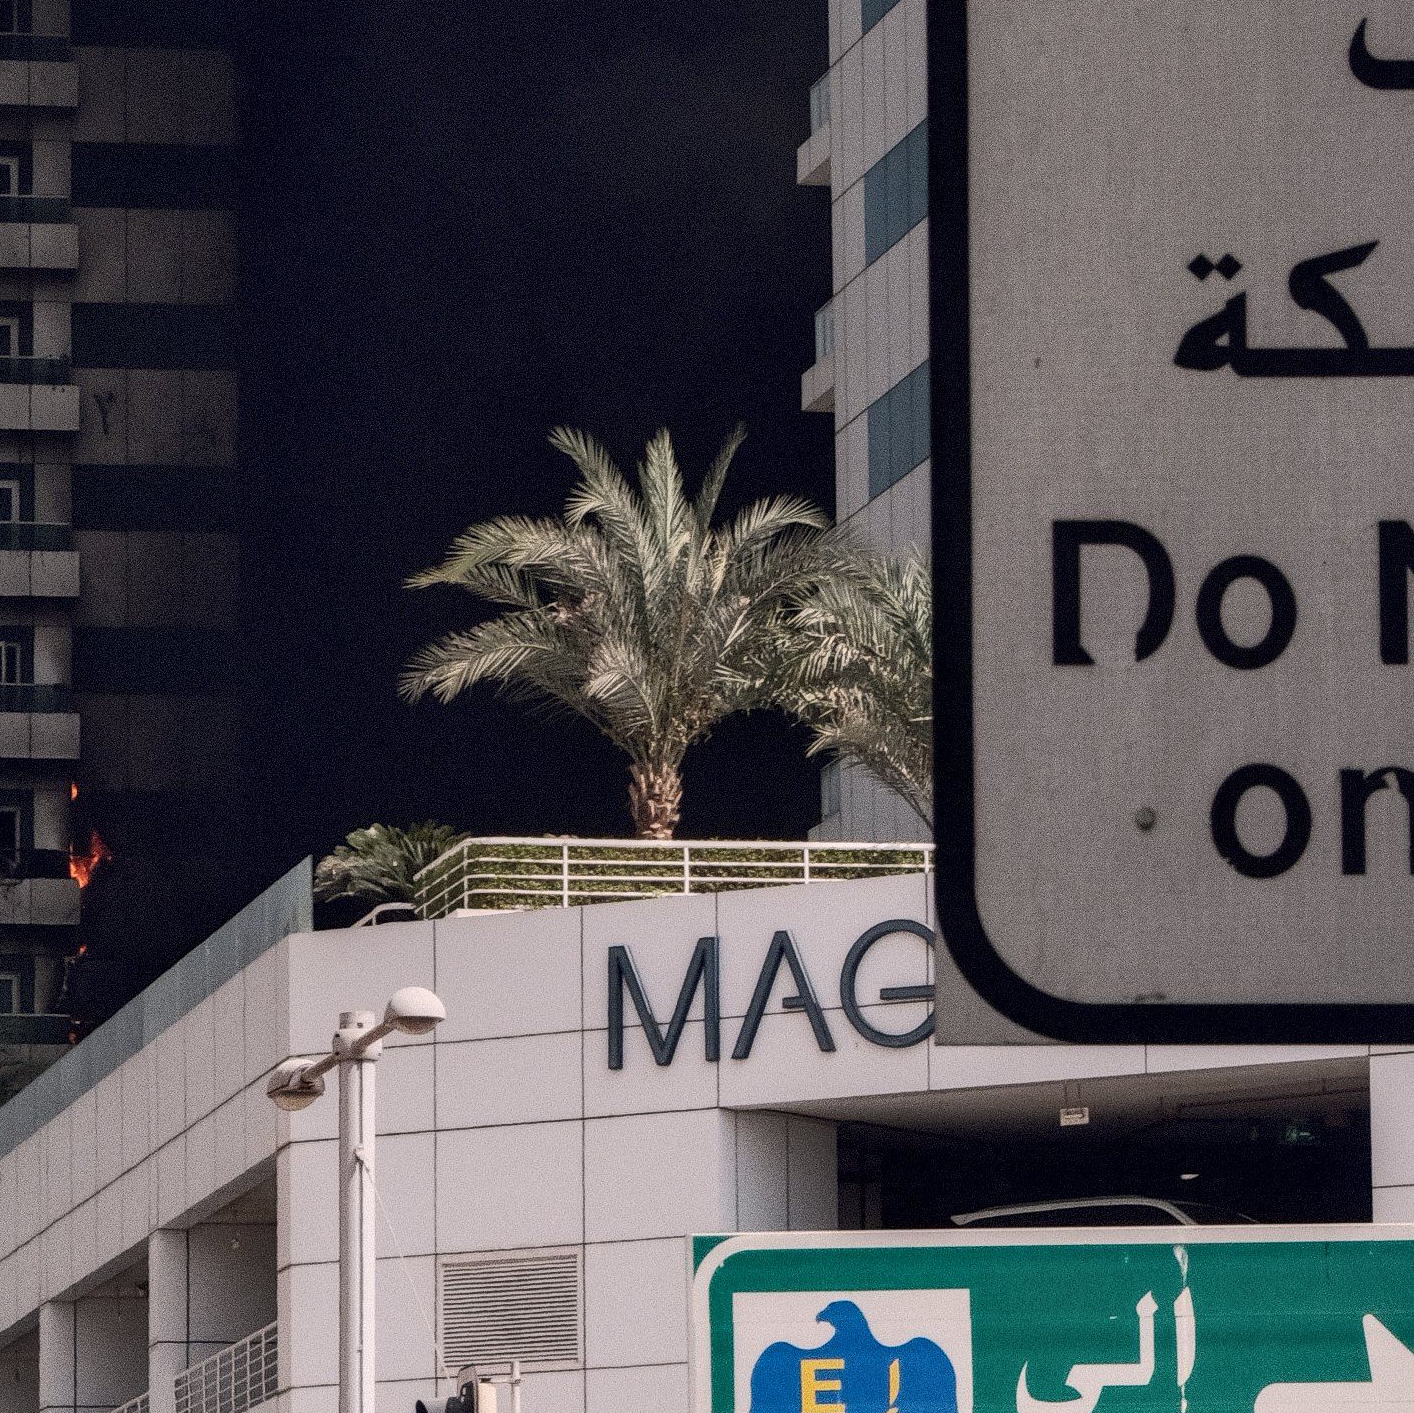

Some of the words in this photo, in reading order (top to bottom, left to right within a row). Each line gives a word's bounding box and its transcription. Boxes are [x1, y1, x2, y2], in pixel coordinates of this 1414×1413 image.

[1052, 519, 1297, 670] Do
[1210, 763, 1414, 878] on
[608, 919, 935, 1070] MAG
